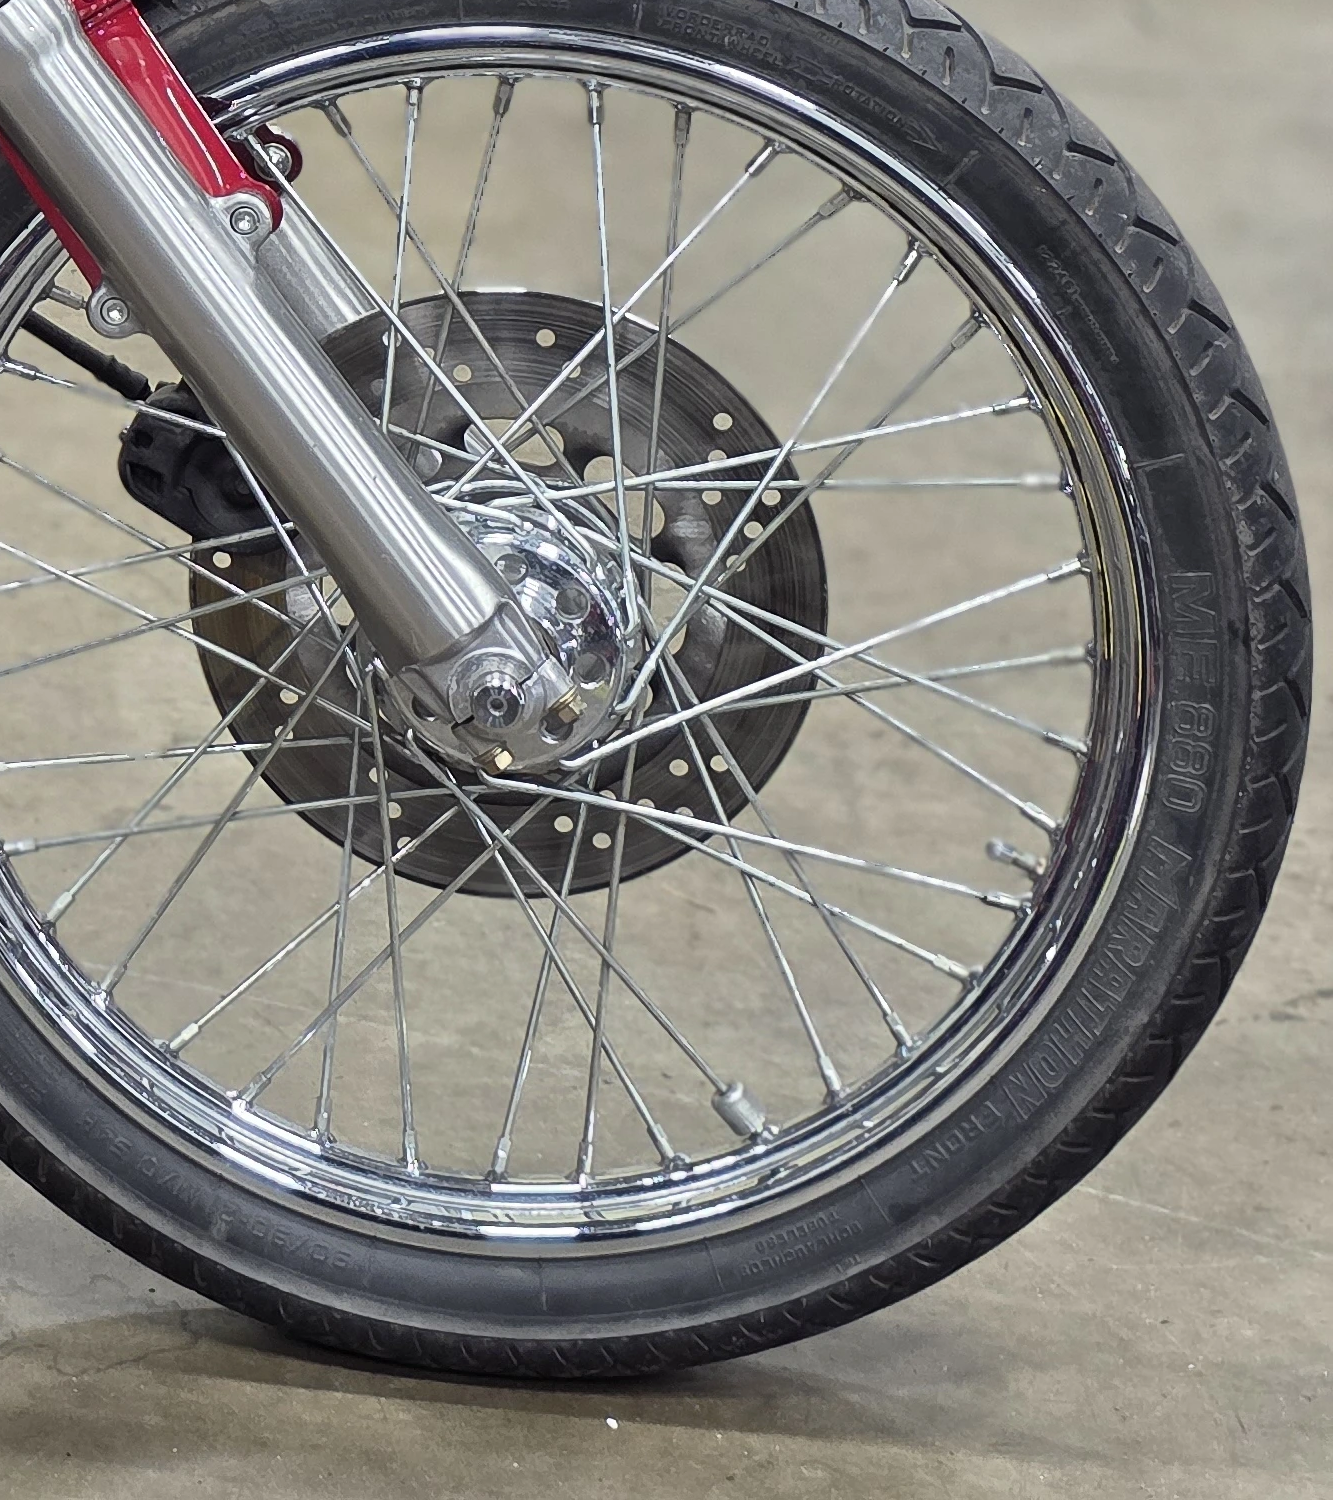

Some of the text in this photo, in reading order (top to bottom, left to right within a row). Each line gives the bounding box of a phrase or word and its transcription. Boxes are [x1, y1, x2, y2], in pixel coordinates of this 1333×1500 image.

[830, 79, 910, 129] ROTATION
[1161, 569, 1220, 817] ME 880
[907, 834, 1193, 1180] MARATHON FRONT
